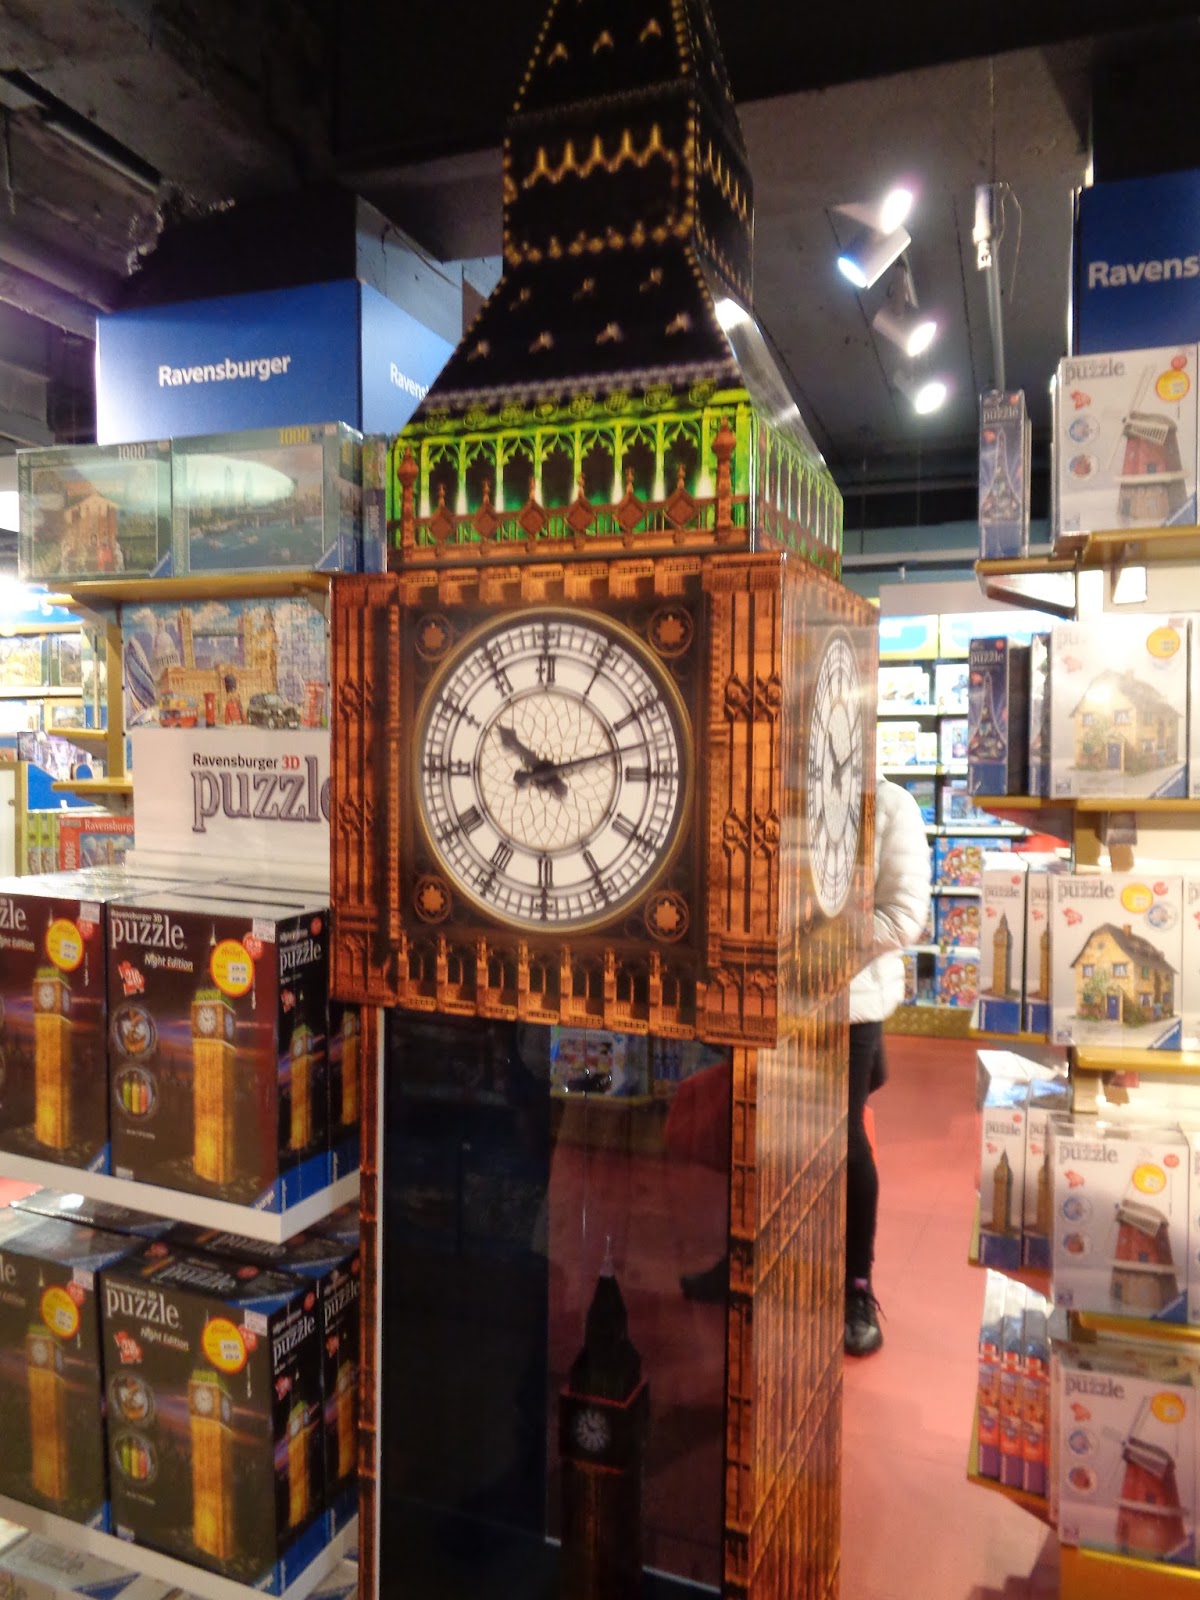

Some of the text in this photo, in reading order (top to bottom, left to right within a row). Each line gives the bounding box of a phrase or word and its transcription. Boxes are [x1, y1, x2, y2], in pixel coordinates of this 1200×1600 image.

[158, 354, 291, 388] Ravensburger
[1065, 358, 1125, 386] puzzle
[118, 443, 146, 460] 1000
[192, 753, 301, 771] Ravensburger 3D
[1058, 880, 1115, 903] puzzle
[110, 914, 185, 951] puzzle
[144, 952, 194, 973] Night Edition
[280, 938, 322, 976] puzzle
[1059, 1143, 1119, 1165] puzzle
[107, 1287, 180, 1329] puzzle
[273, 1315, 316, 1368] puzzle
[1065, 1376, 1125, 1399] puzzle
